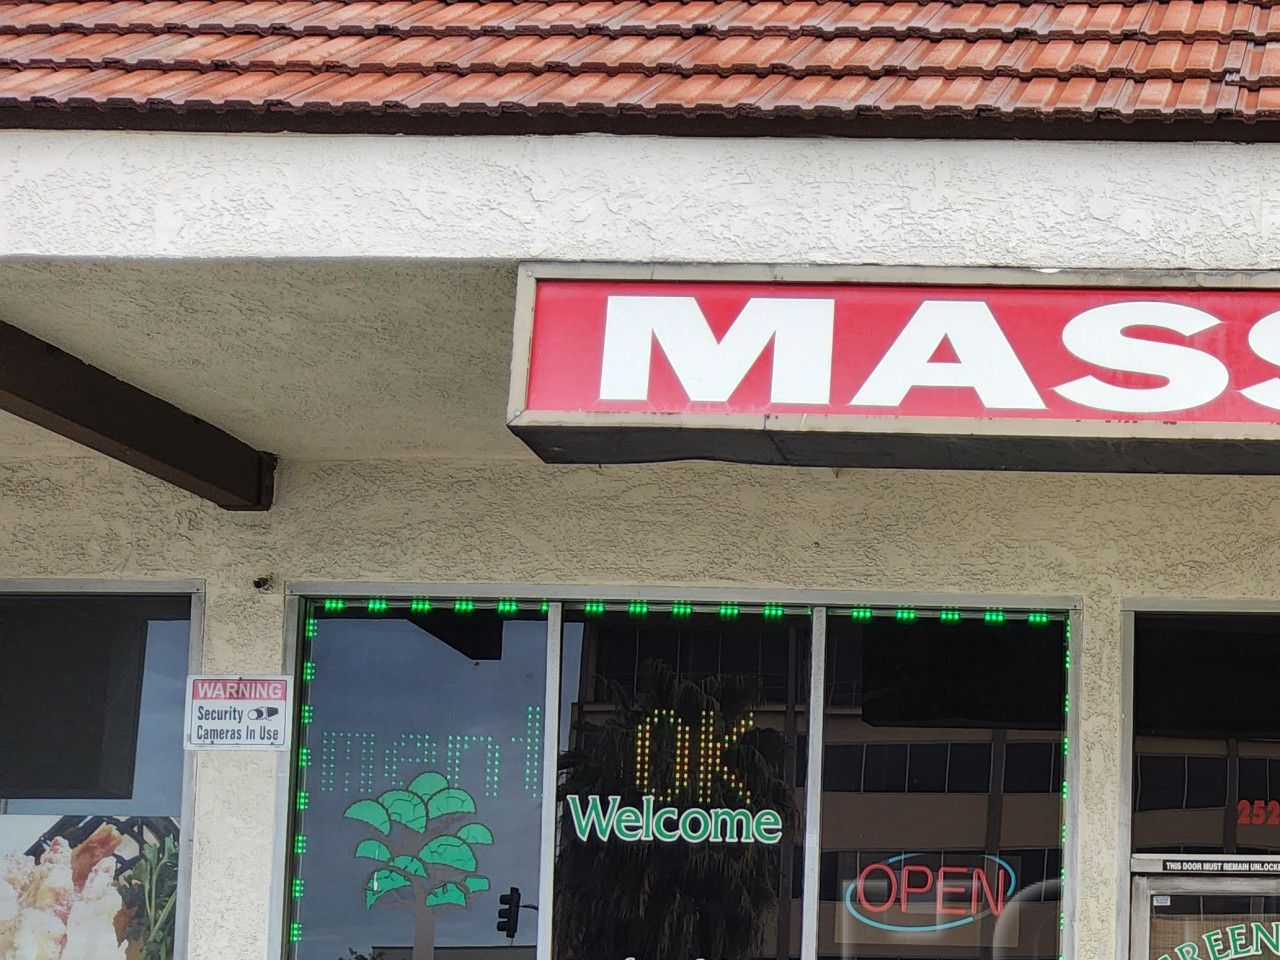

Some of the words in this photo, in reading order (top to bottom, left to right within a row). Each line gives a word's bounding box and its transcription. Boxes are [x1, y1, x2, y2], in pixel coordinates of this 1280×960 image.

[198, 682, 282, 699] WARNING
[197, 706, 244, 724] Security
[196, 725, 242, 740] Cameras
[245, 725, 256, 740] In
[259, 725, 279, 740] Use
[568, 794, 783, 843] Welcome
[1166, 862, 1181, 870] THIS
[1183, 862, 1201, 870] DOOR
[1203, 862, 1222, 871] MUST
[1223, 862, 1249, 871] REMAIN
[857, 863, 1005, 916] OPEN
